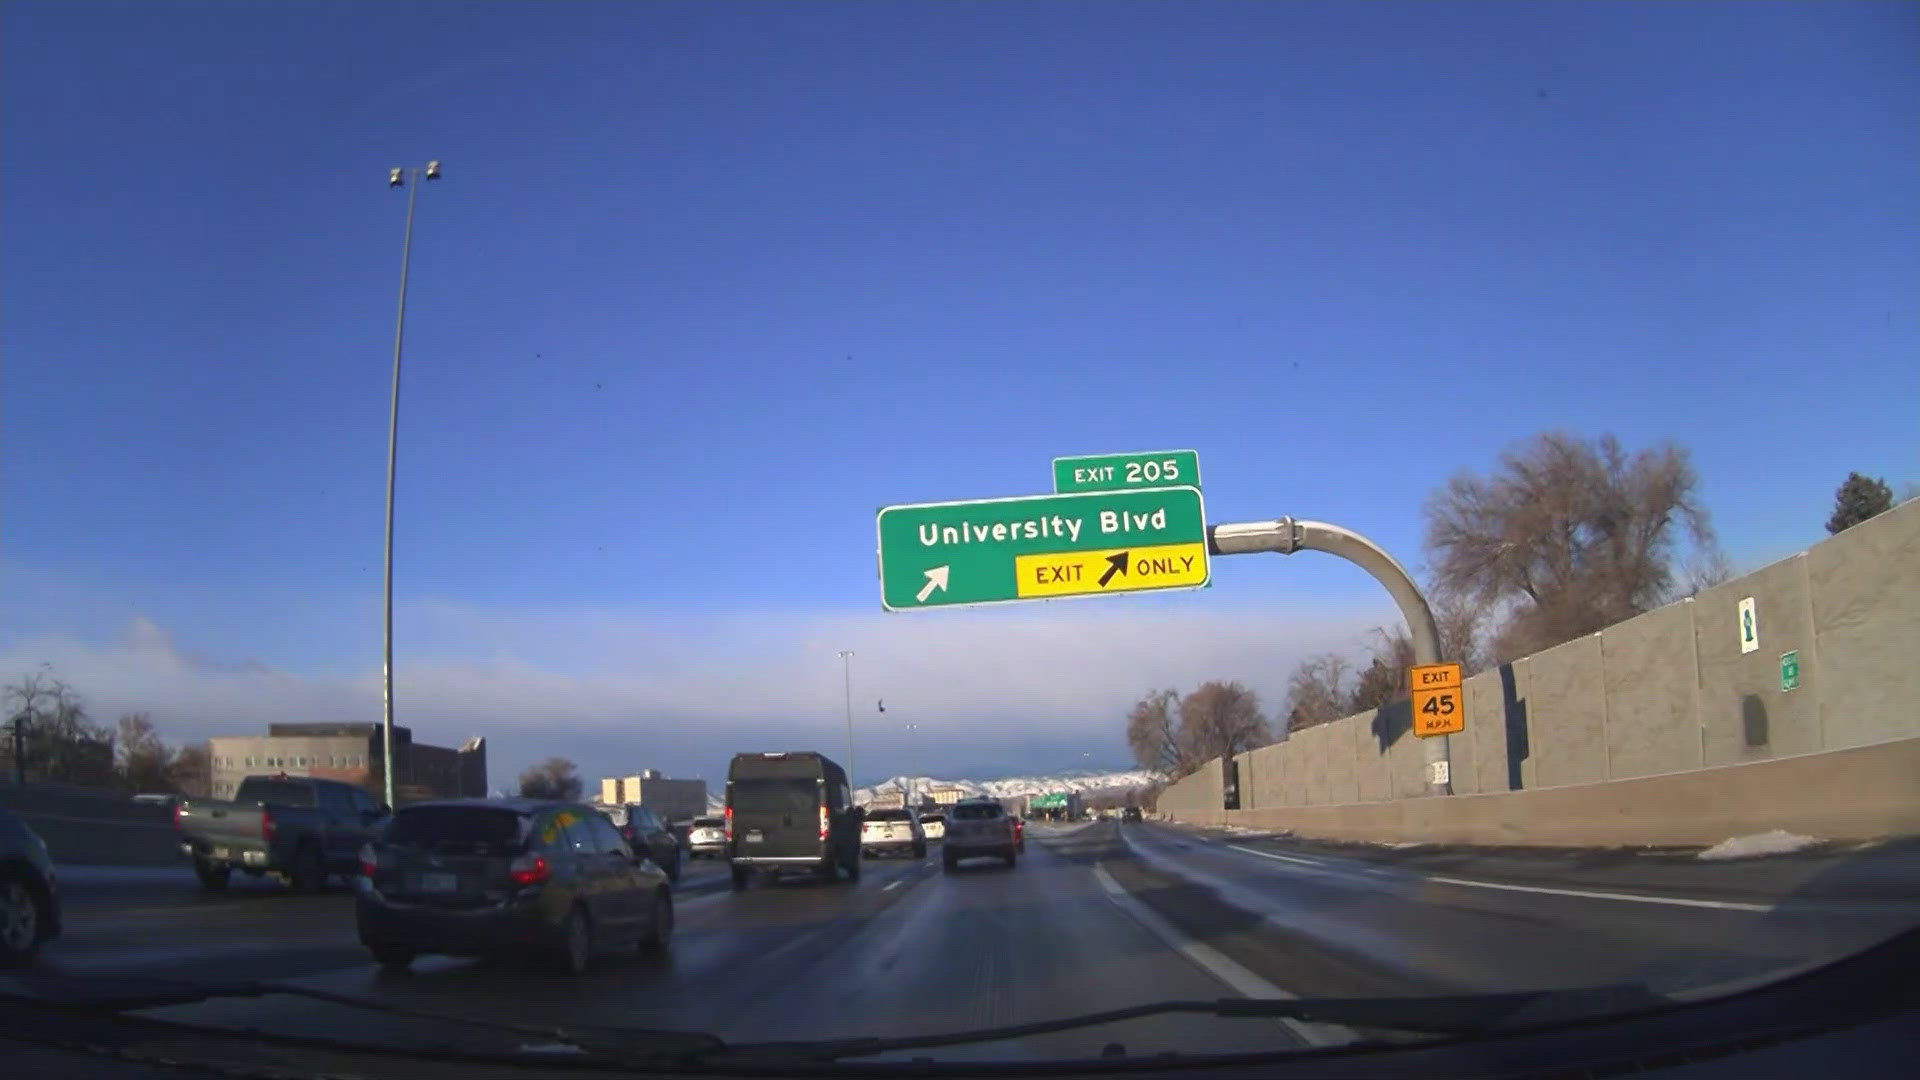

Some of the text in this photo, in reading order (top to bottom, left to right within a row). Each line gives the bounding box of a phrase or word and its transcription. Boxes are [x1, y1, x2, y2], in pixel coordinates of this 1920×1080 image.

[1074, 459, 1179, 483] EXIT 205
[918, 508, 1166, 546] University Blvd
[1036, 555, 1194, 584] EXIT ONLY
[1422, 671, 1449, 684] EXIT
[1422, 695, 1455, 716] 45
